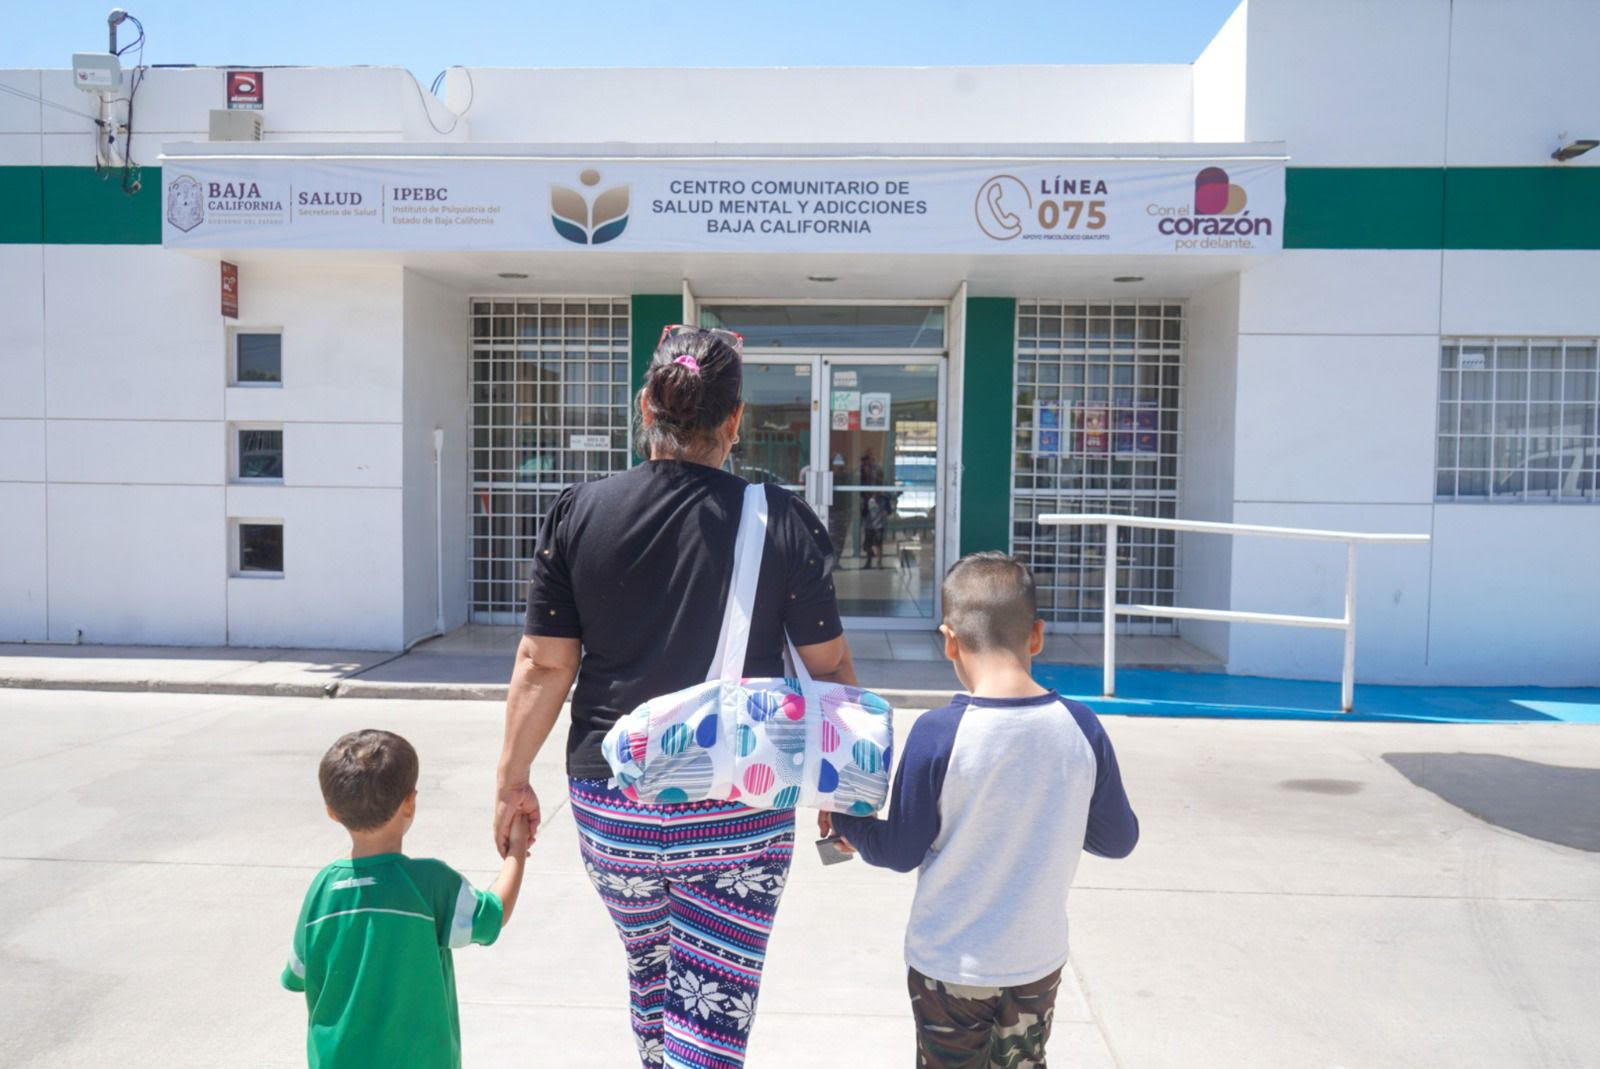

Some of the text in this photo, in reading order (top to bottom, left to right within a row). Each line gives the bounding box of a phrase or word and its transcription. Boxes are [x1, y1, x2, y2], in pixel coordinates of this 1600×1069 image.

[208, 182, 262, 200] BAJA
[670, 180, 909, 195] CENTRO COMUNITARIO DE
[1041, 175, 1108, 195] LÍNEA
[298, 191, 363, 206] SALUD
[393, 187, 448, 201] IPEBC
[208, 201, 283, 211] CALIFORNIA
[299, 208, 377, 217] Secretaria de Salud
[392, 205, 427, 214] Instituto
[430, 205, 439, 214] de
[487, 205, 501, 214] del
[652, 200, 927, 214] SALUD MENTAL Y ADICCIONES
[1146, 203, 1190, 216] Con el
[392, 216, 494, 227] Estado de Baja California
[1037, 200, 1107, 229] 075
[707, 219, 871, 234] BAJA CALIFORNIA
[1158, 210, 1272, 235] corazón
[1175, 237, 1255, 251] por delante.
